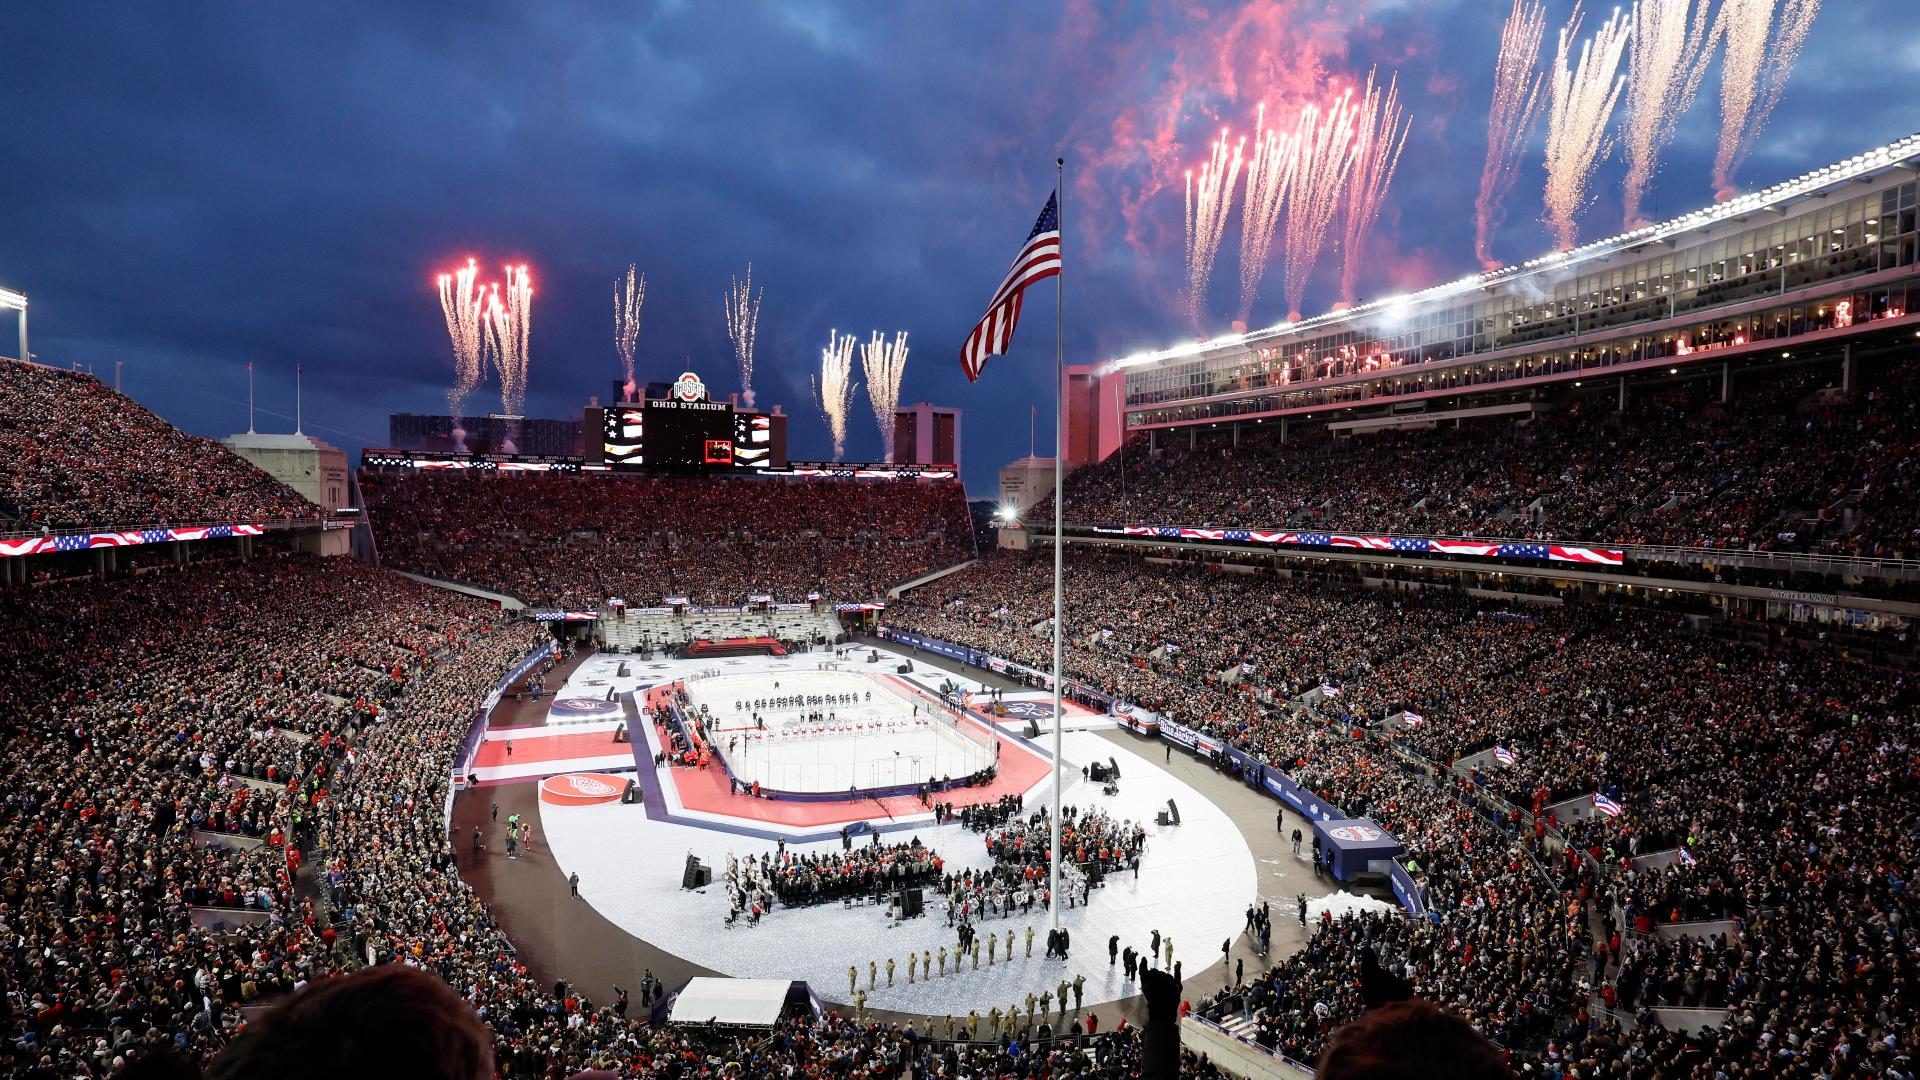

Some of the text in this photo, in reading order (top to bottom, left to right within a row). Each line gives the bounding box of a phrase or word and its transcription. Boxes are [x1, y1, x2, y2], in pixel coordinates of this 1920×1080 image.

[652, 401, 727, 411] OHIO STADIUM
[1801, 592, 1836, 603] LANDING
[1159, 719, 1198, 747] Blue Jacket
